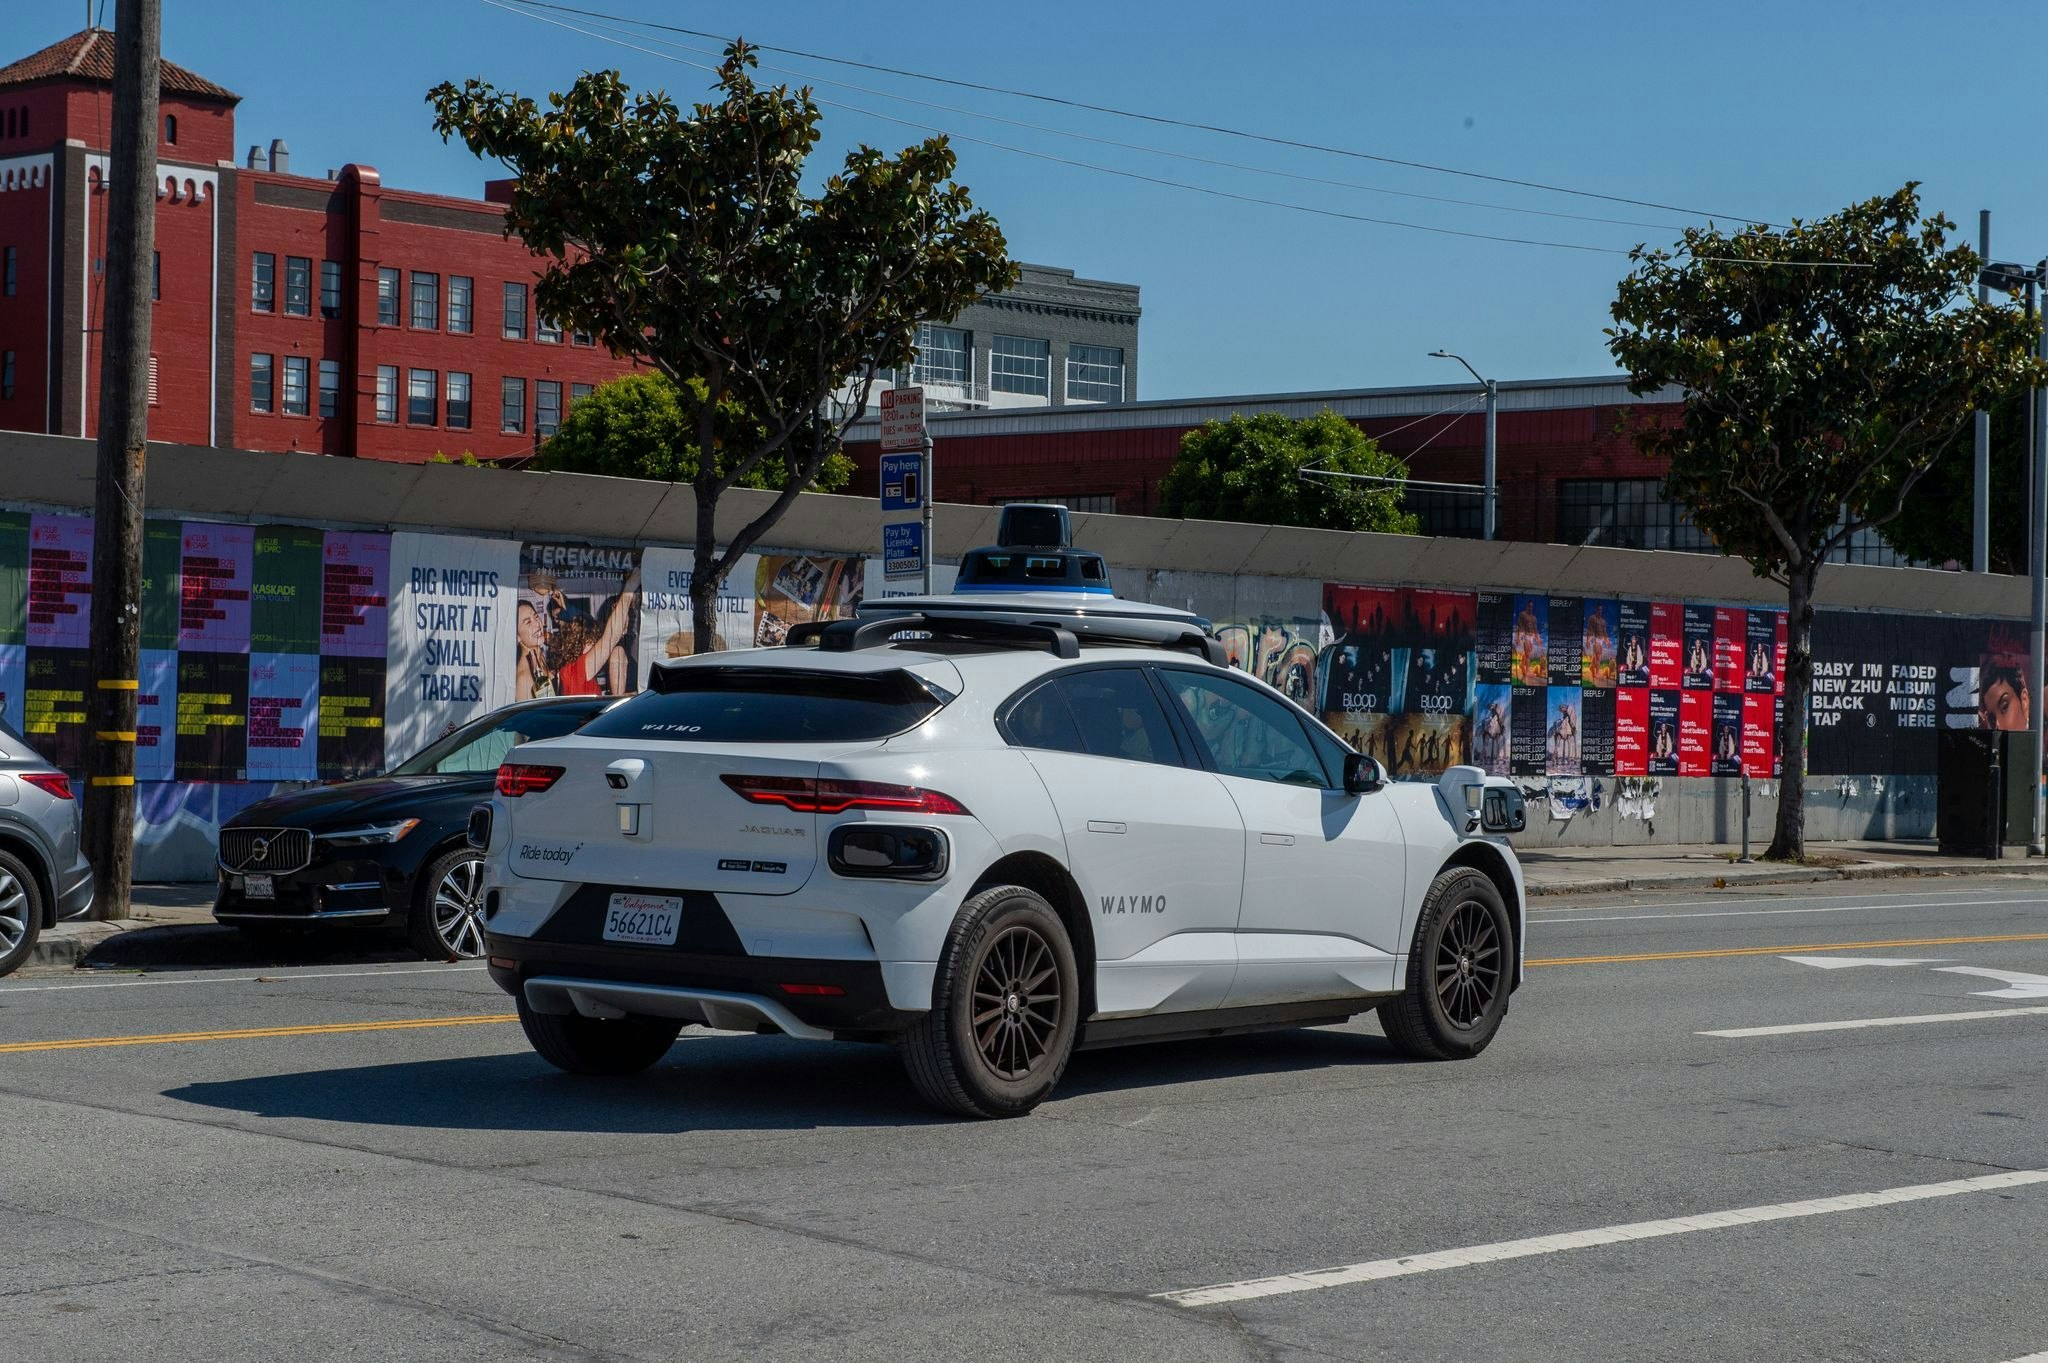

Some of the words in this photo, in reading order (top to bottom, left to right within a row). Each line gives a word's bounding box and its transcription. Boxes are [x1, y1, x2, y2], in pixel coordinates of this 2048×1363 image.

[883, 392, 893, 408] NO
[896, 393, 922, 405] PARKING
[883, 425, 896, 435] TUES
[905, 423, 921, 433] THURS
[883, 461, 898, 474] Pay
[900, 460, 919, 470] here
[885, 528, 899, 538] Pay
[901, 526, 911, 538] by
[262, 537, 278, 545] CLUB
[886, 538, 913, 548] License
[72, 551, 88, 561] B2B
[530, 544, 634, 570] TEREMANA
[886, 548, 905, 558] Plate
[888, 560, 919, 571] 33005003
[63, 572, 80, 582] B2B
[536, 567, 561, 577] SMALL
[564, 571, 589, 579] BATCH
[593, 571, 625, 581] TEQUILA
[668, 570, 693, 589] EVER
[411, 567, 437, 595] BIG
[441, 569, 499, 599] NIGHTS
[252, 583, 296, 596] KASKADE
[647, 592, 668, 610] HAS
[669, 593, 677, 610] A
[725, 595, 749, 614] TELL.
[417, 603, 468, 632] START
[471, 606, 491, 632] AT
[426, 638, 480, 667] SMALL
[1549, 648, 1582, 656] INFINITE_LOOP
[1549, 656, 1582, 664] INFINITE_LOOP
[1549, 664, 1582, 672] INFINITE_LOOP
[1812, 662, 1854, 677] BABY
[1862, 664, 1883, 678] I'M
[1892, 665, 1937, 680] FADED
[420, 674, 483, 702] TABLES.
[1812, 678, 1847, 693] NEW
[1850, 679, 1882, 694] ZHU
[1885, 681, 1936, 695] ALBUM
[26, 690, 61, 701] CHRIS
[61, 691, 84, 702] LAKE
[178, 693, 208, 703] CHRIS
[208, 694, 231, 704] LAKE
[1343, 693, 1377, 708] BLOOD
[25, 701, 54, 711] ATRIP
[250, 697, 280, 708] CHRIS
[280, 698, 302, 708] LAKE
[319, 696, 349, 707] CHRIS
[349, 697, 370, 708] LAKE
[1420, 694, 1453, 710] BLOOD
[1812, 695, 1864, 710] BLACK
[1890, 697, 1936, 711] MIDAS
[178, 703, 205, 714] ATRIP
[250, 707, 282, 718] SALUTE
[319, 706, 345, 717] ATRIP
[1345, 706, 1373, 721] SAGA
[25, 711, 60, 722] MARCO
[177, 714, 211, 724] MARCO
[1423, 708, 1450, 721] SAGA
[1812, 712, 1842, 726] TAP
[1897, 714, 1936, 727] HERE
[249, 718, 280, 729] JACKIE
[319, 716, 351, 727] MARCO
[249, 728, 304, 738] HOLLANDER
[641, 724, 702, 734] WAYMO
[249, 738, 301, 748] AMPRS&ND
[1511, 737, 1545, 745] INFINITE_LOOP
[1582, 737, 1615, 746] INFINITE_LOOP
[1511, 745, 1545, 753] INFINITE_LOOP
[1582, 746, 1615, 754] INFINITE_LOOP
[1511, 753, 1546, 761] INFINITE_LOOP
[1582, 753, 1615, 761] INFINITE_LOOP
[738, 825, 807, 837] JAGUAR
[519, 844, 542, 860] Ride
[542, 846, 575, 866] today
[623, 896, 667, 911] California
[1100, 894, 1167, 915] WAYMO
[609, 911, 673, 937] 56621C4
